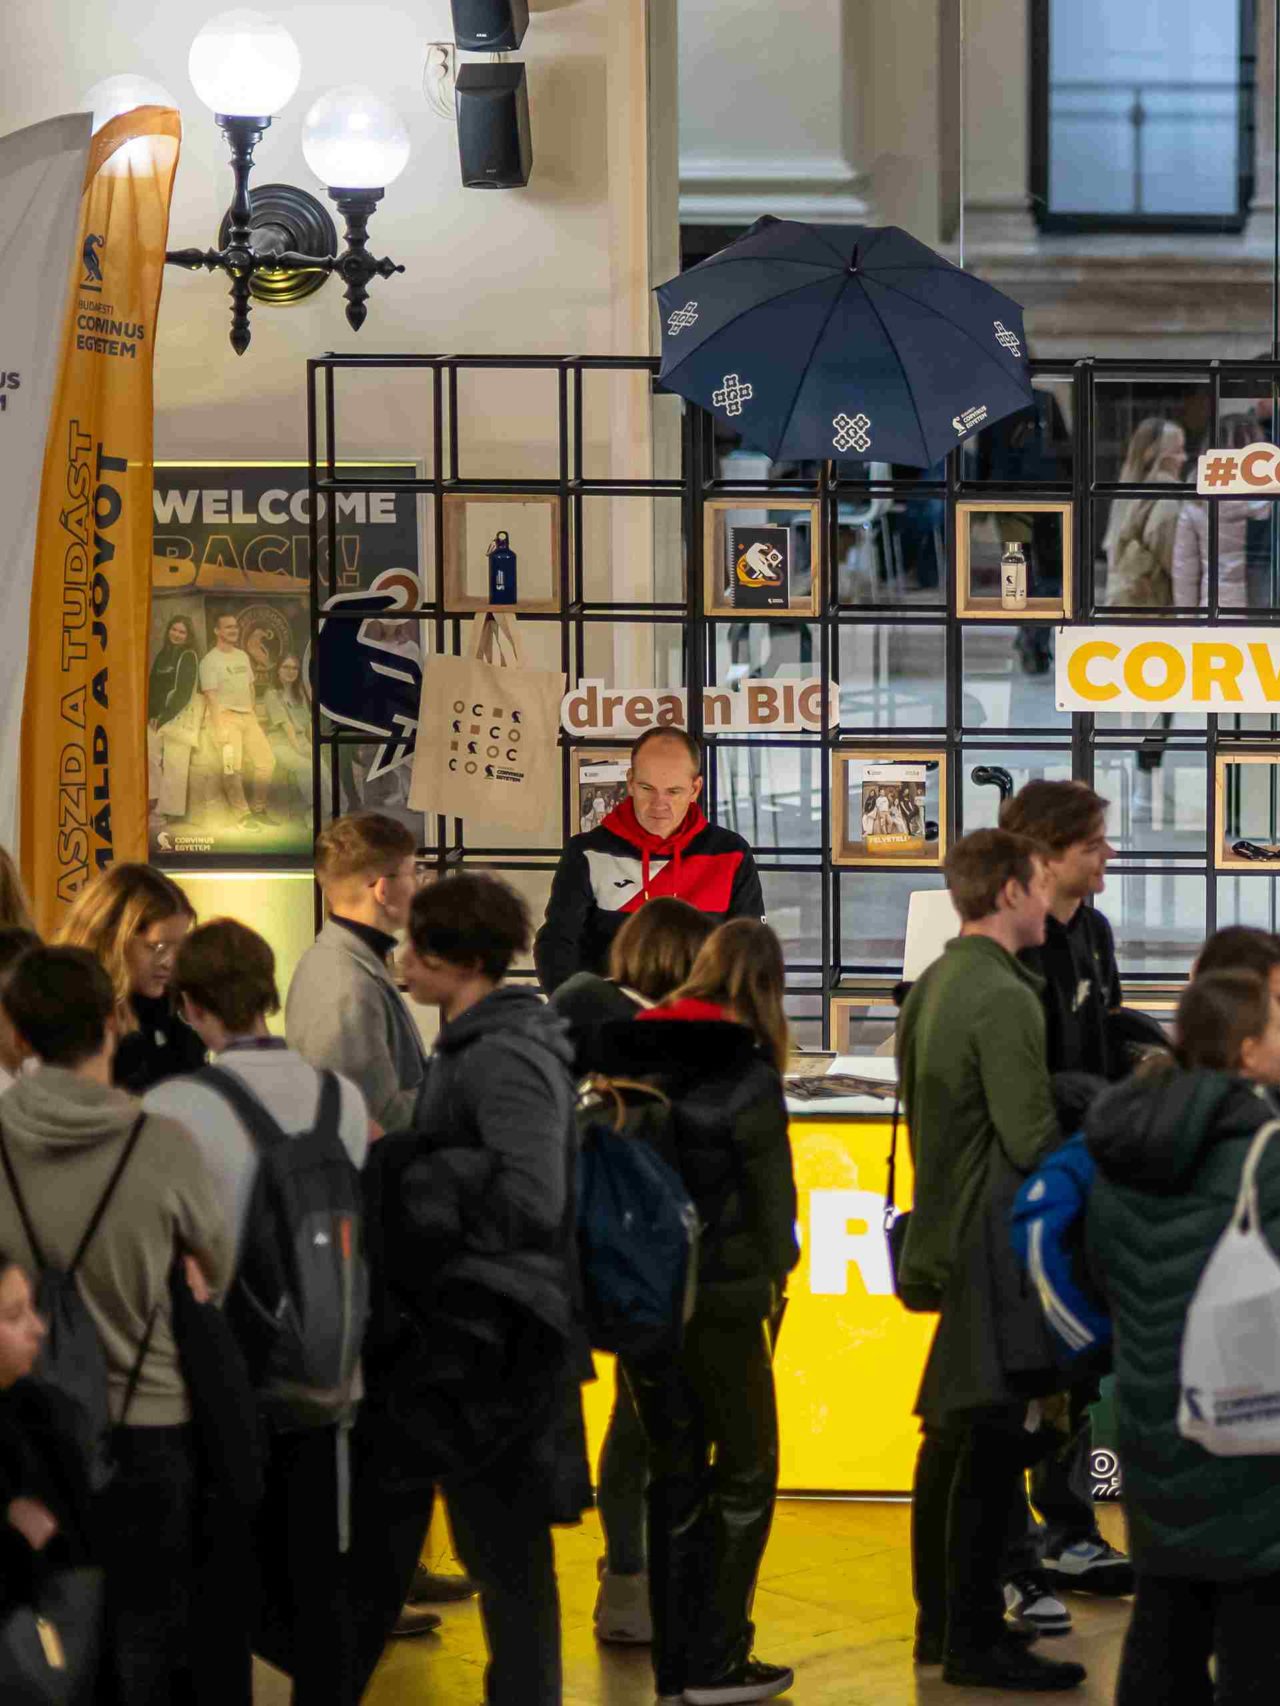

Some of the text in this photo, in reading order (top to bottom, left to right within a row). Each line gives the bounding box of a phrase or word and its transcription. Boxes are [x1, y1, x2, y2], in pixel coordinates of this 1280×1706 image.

[153, 489, 397, 524] WELCOME
[58, 420, 92, 672] TUDÁST
[153, 535, 360, 588] BACK!
[61, 684, 87, 730] A
[92, 667, 109, 710] A
[568, 684, 833, 728] dream BIG
